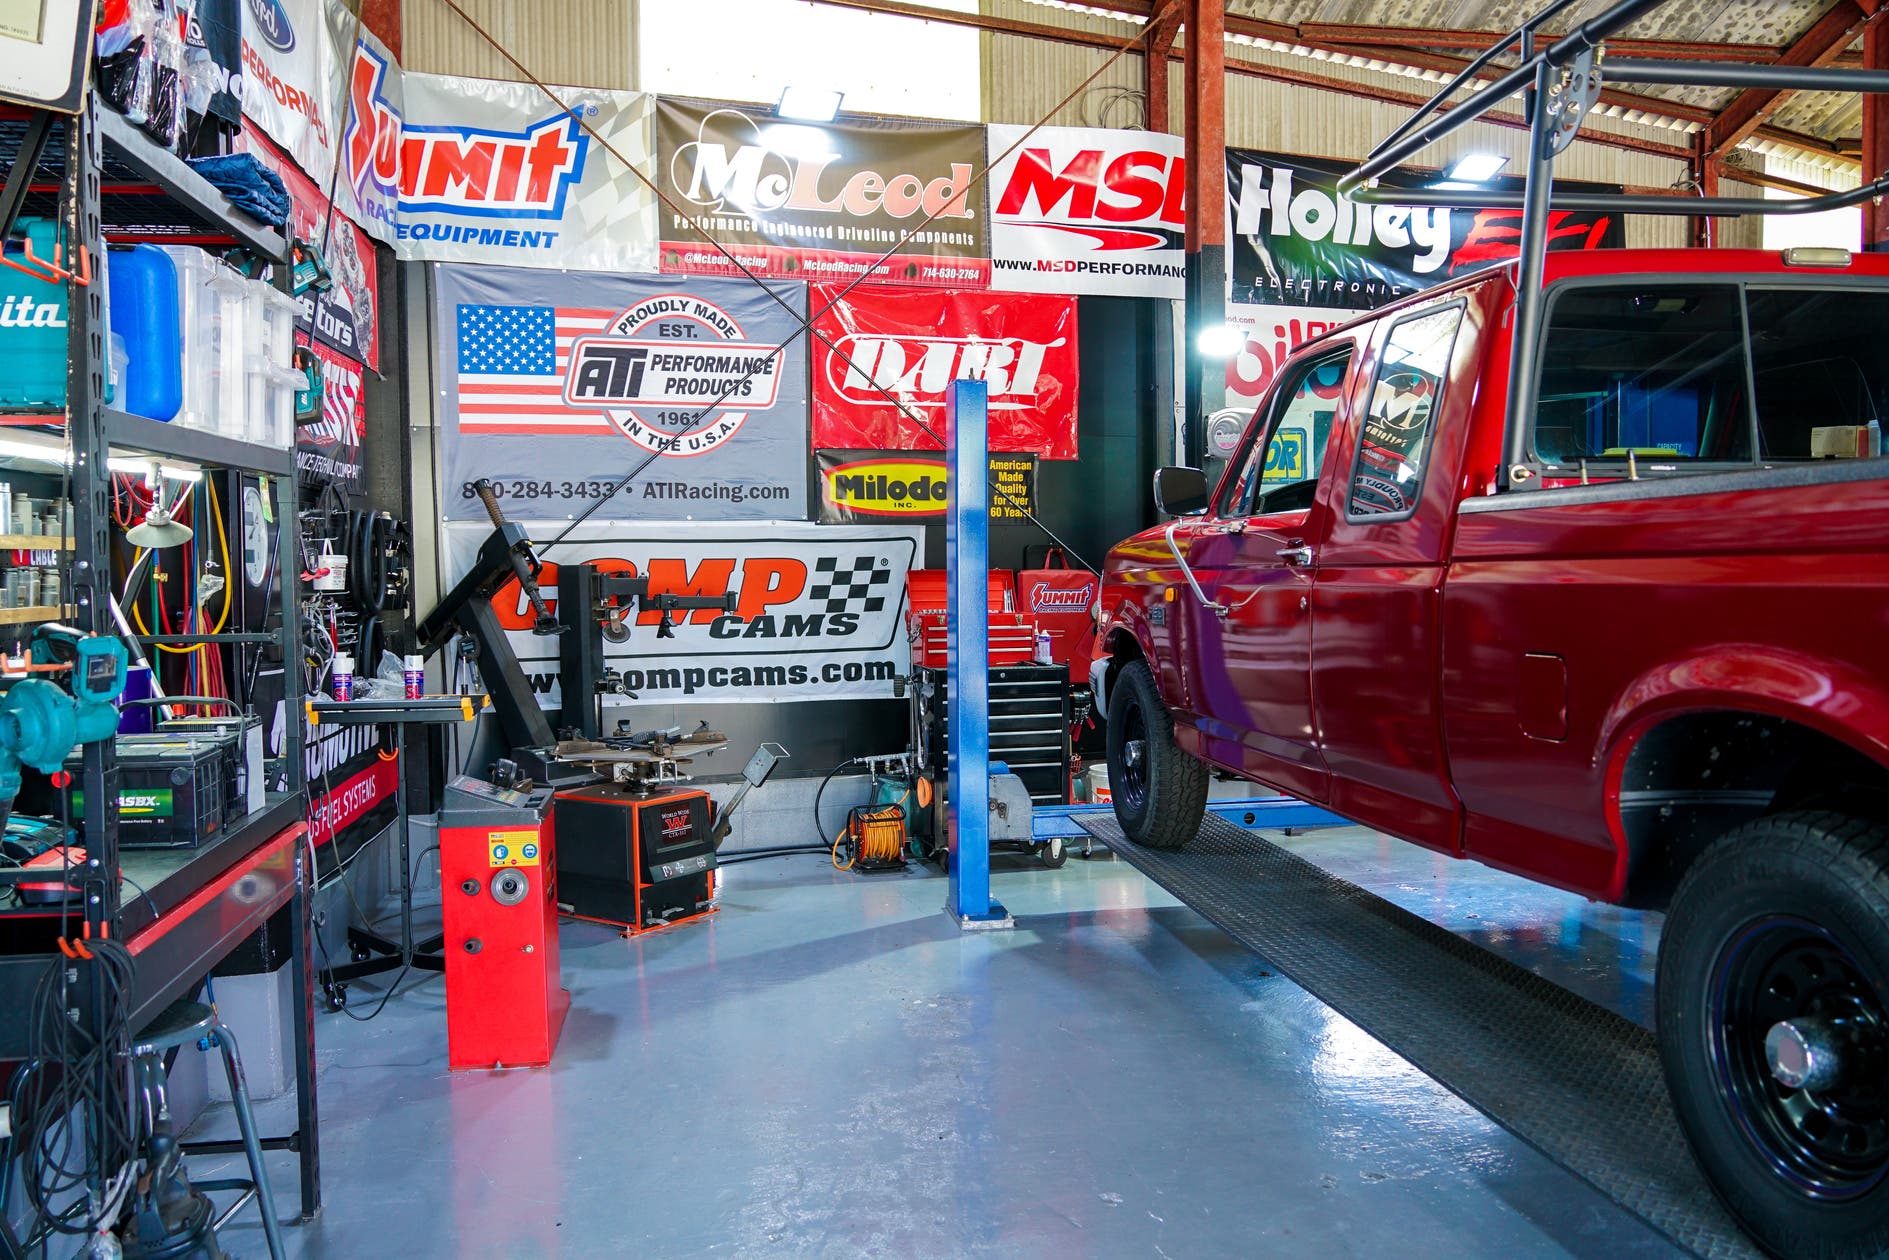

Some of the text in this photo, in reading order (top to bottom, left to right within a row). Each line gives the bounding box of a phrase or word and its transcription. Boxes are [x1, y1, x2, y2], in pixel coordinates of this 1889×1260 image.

[673, 214, 975, 247] Performance Engineered Driveline Components
[1236, 163, 1451, 273] Holley
[396, 222, 559, 249] EQUIPMENT
[922, 267, 980, 281] 714-630-2764
[0, 296, 66, 328] ita
[617, 299, 737, 340] PROUDLY MADE
[658, 323, 698, 338] EST.
[575, 347, 775, 398] ATI PERFORMANCE
[838, 336, 1064, 400] DART
[664, 377, 753, 397] PRODUCTS
[657, 411, 701, 426] 1961
[622, 417, 736, 451] IN THE U.S.A.
[990, 459, 1032, 470] American
[998, 471, 1024, 482] Made
[461, 481, 790, 503] 80-284-3433 ATIRacing.com
[835, 474, 947, 502] Milodo
[993, 495, 1007, 506] for
[995, 483, 1027, 496] Quality
[990, 507, 1002, 518] 60
[708, 612, 860, 639] CAMS
[343, 774, 376, 817] SYSTEMS
